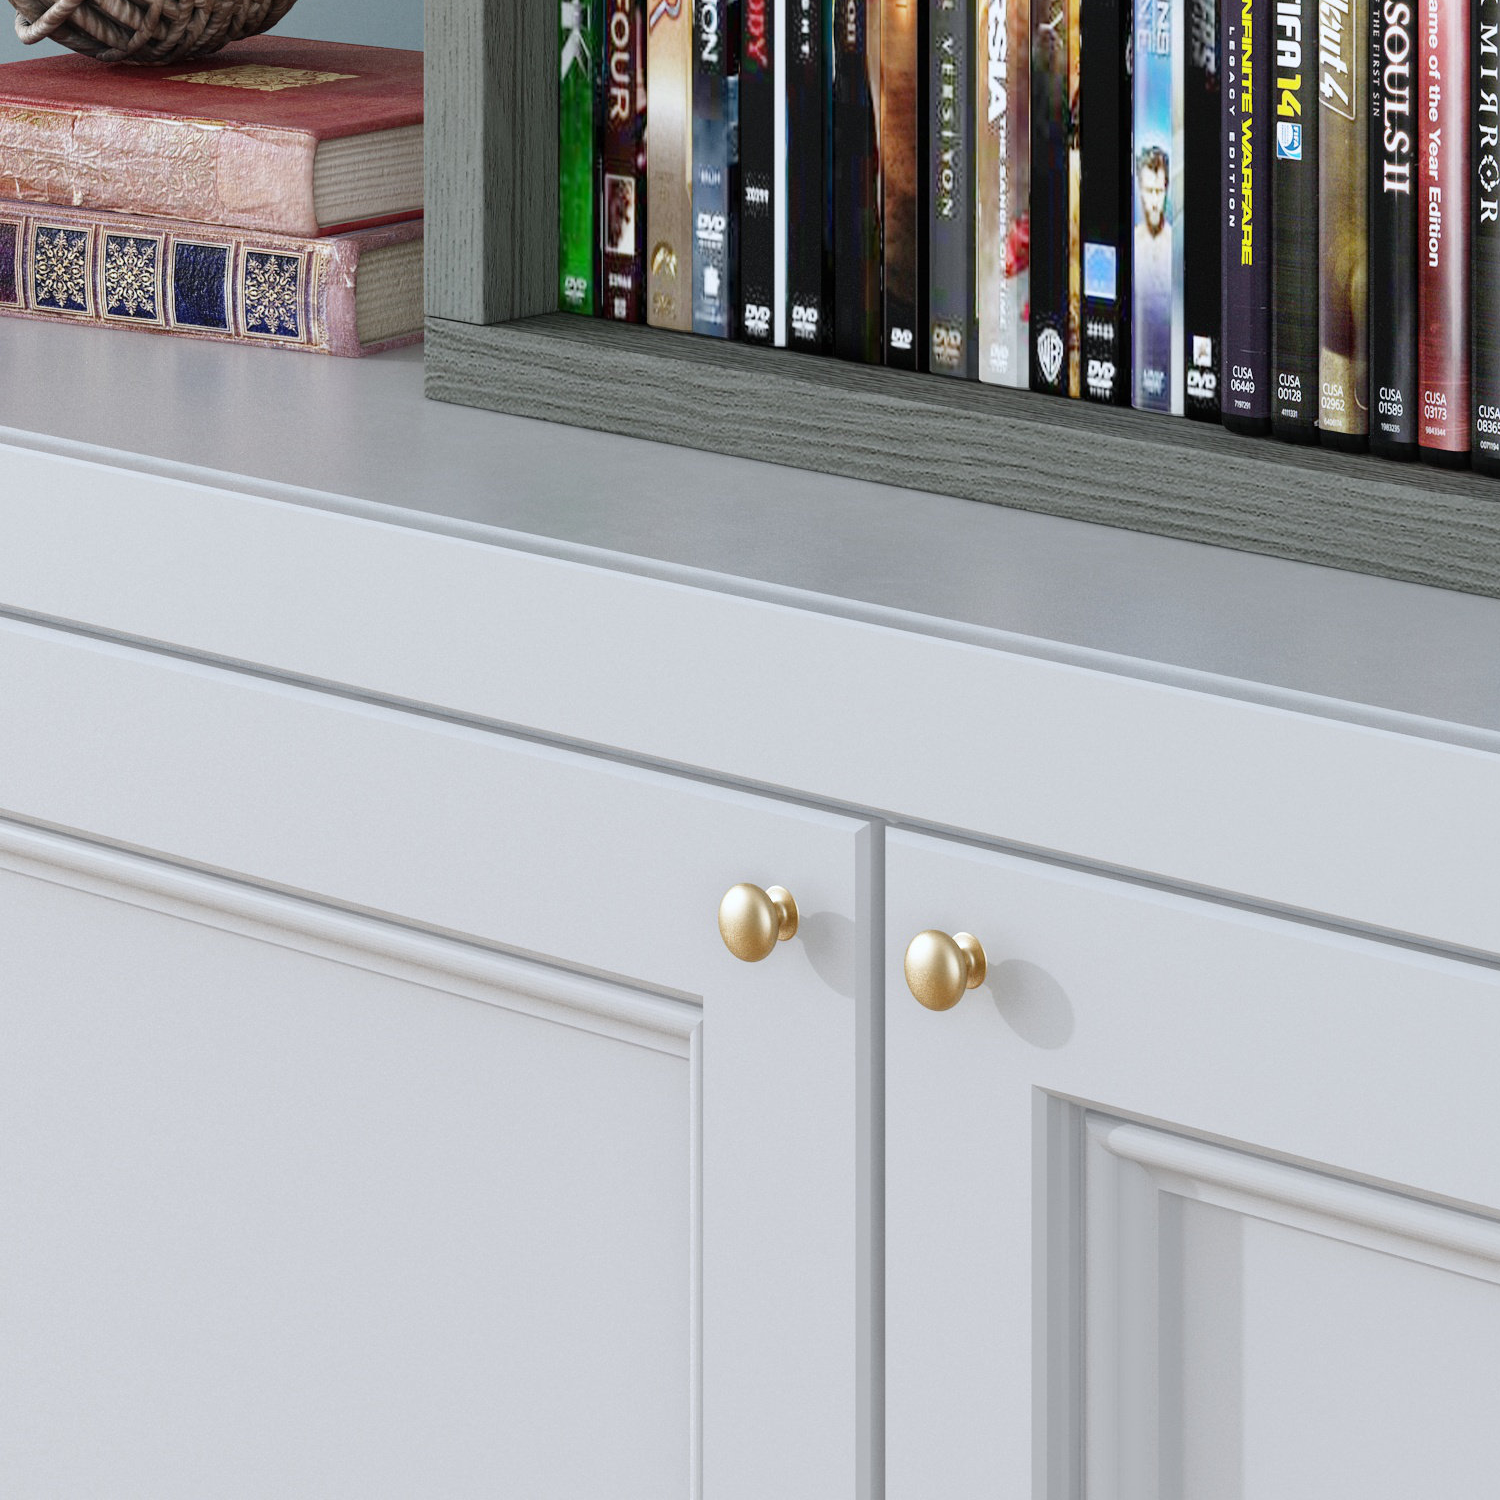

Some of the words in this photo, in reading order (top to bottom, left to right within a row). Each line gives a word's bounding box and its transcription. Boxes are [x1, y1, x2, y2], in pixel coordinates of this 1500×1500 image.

[1372, 10, 1380, 37] THE
[1228, 26, 1236, 115] LEGACY
[1372, 44, 1380, 87] FIRST
[1383, 0, 1410, 154] SOULS
[1428, 55, 1441, 80] of
[1276, 74, 1302, 117] 14
[1320, 71, 1349, 106] 4
[1372, 91, 1380, 117] SIN
[1428, 84, 1441, 123] the
[1428, 128, 1441, 182] Year
[1228, 131, 1236, 227] EDITION
[1383, 159, 1410, 196] II
[1241, 118, 1253, 267] WARFARE
[1428, 186, 1442, 268] Edition
[1232, 365, 1253, 380] CUSA
[1278, 373, 1301, 388] CUSA
[1230, 379, 1255, 394] 06449
[1277, 387, 1302, 403] 00128
[1322, 382, 1344, 398] CUSA
[1379, 386, 1402, 402] CUSA
[1424, 390, 1447, 406] CUSA
[1320, 396, 1345, 412] 02962
[1378, 401, 1404, 417] 01589
[1478, 404, 1500, 420] CUSA
